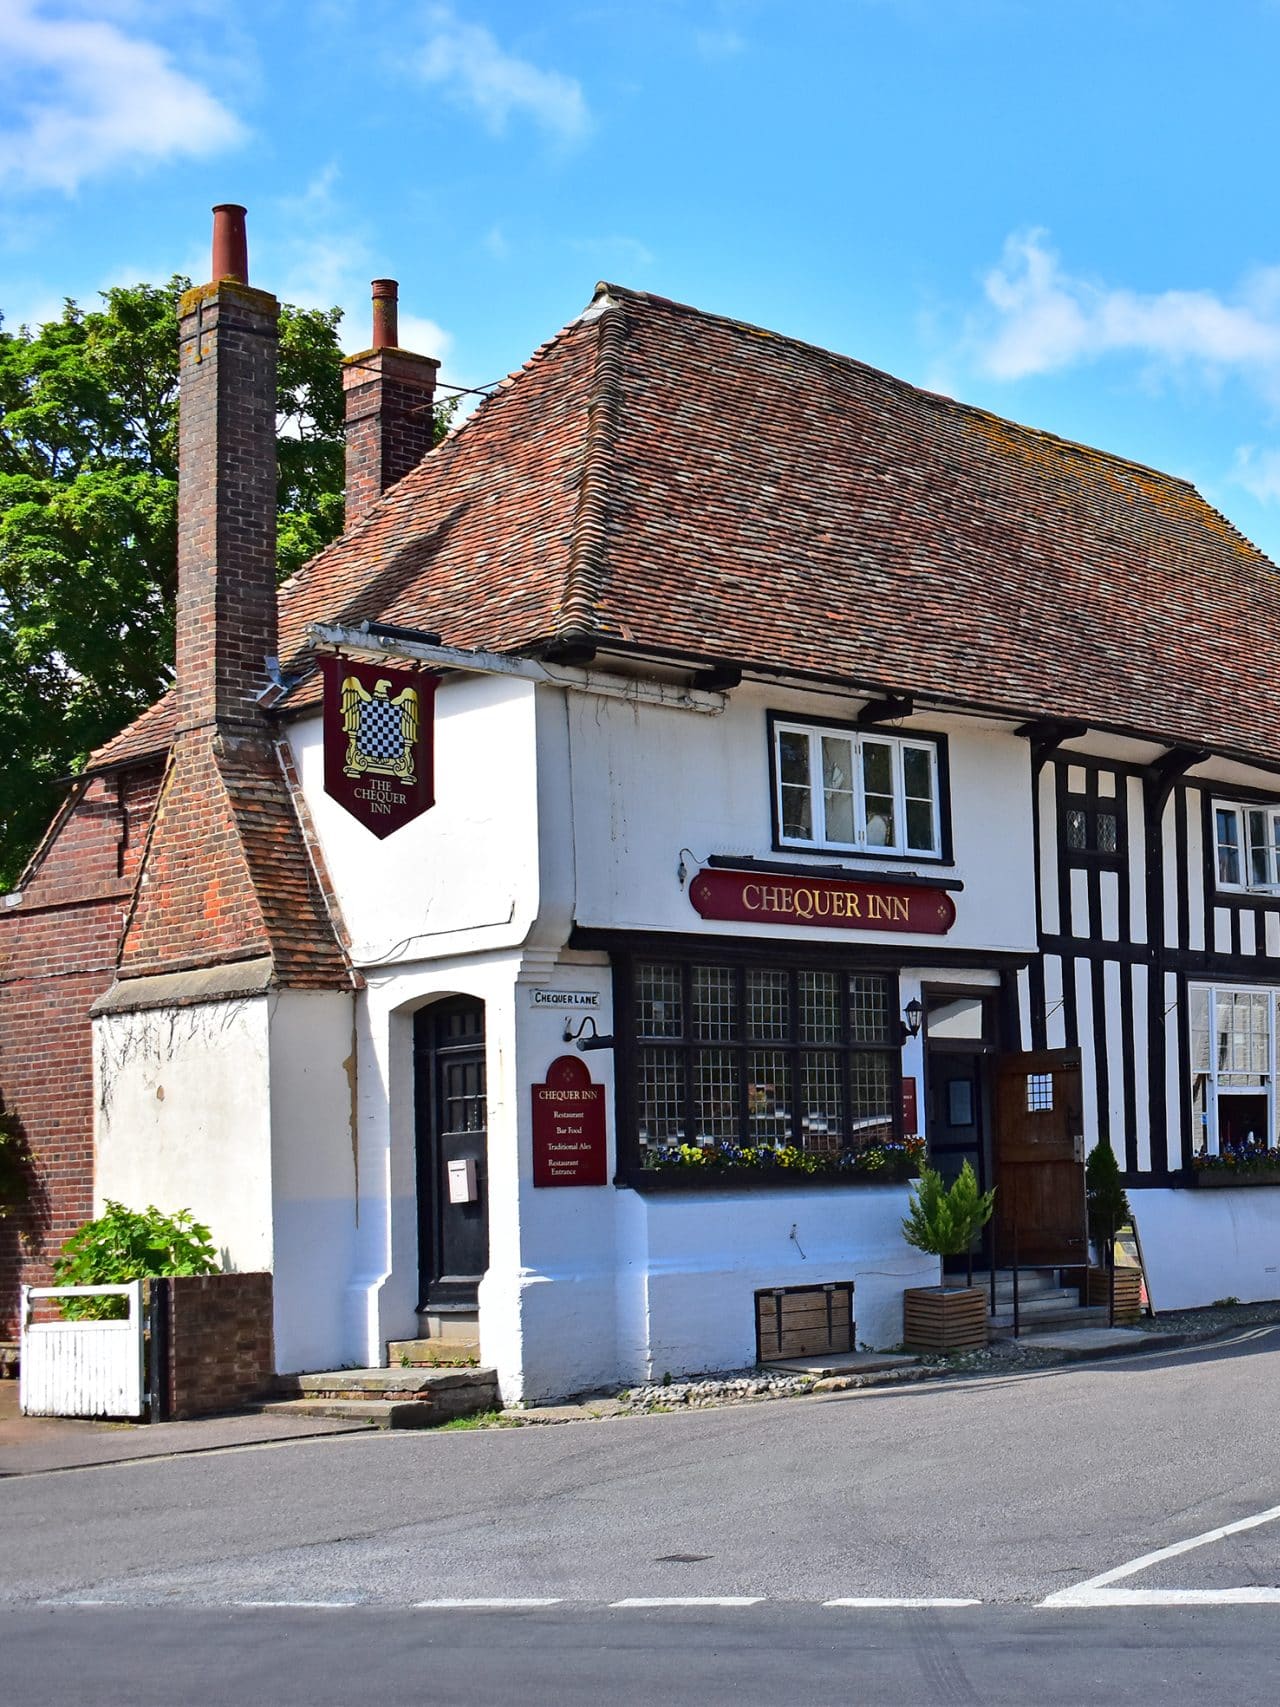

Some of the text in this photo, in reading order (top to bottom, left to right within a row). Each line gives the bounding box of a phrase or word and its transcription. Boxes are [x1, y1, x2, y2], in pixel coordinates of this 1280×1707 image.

[369, 779, 392, 791] THE
[353, 788, 407, 804] CHEQUER
[370, 803, 392, 815] INN
[742, 884, 911, 921] CHEQUER INN
[535, 992, 598, 1005] CHEQUER LANE
[539, 1090, 598, 1101] CHEQUER INN
[547, 1143, 578, 1151] Traditional
[551, 1168, 576, 1176] Entrance
